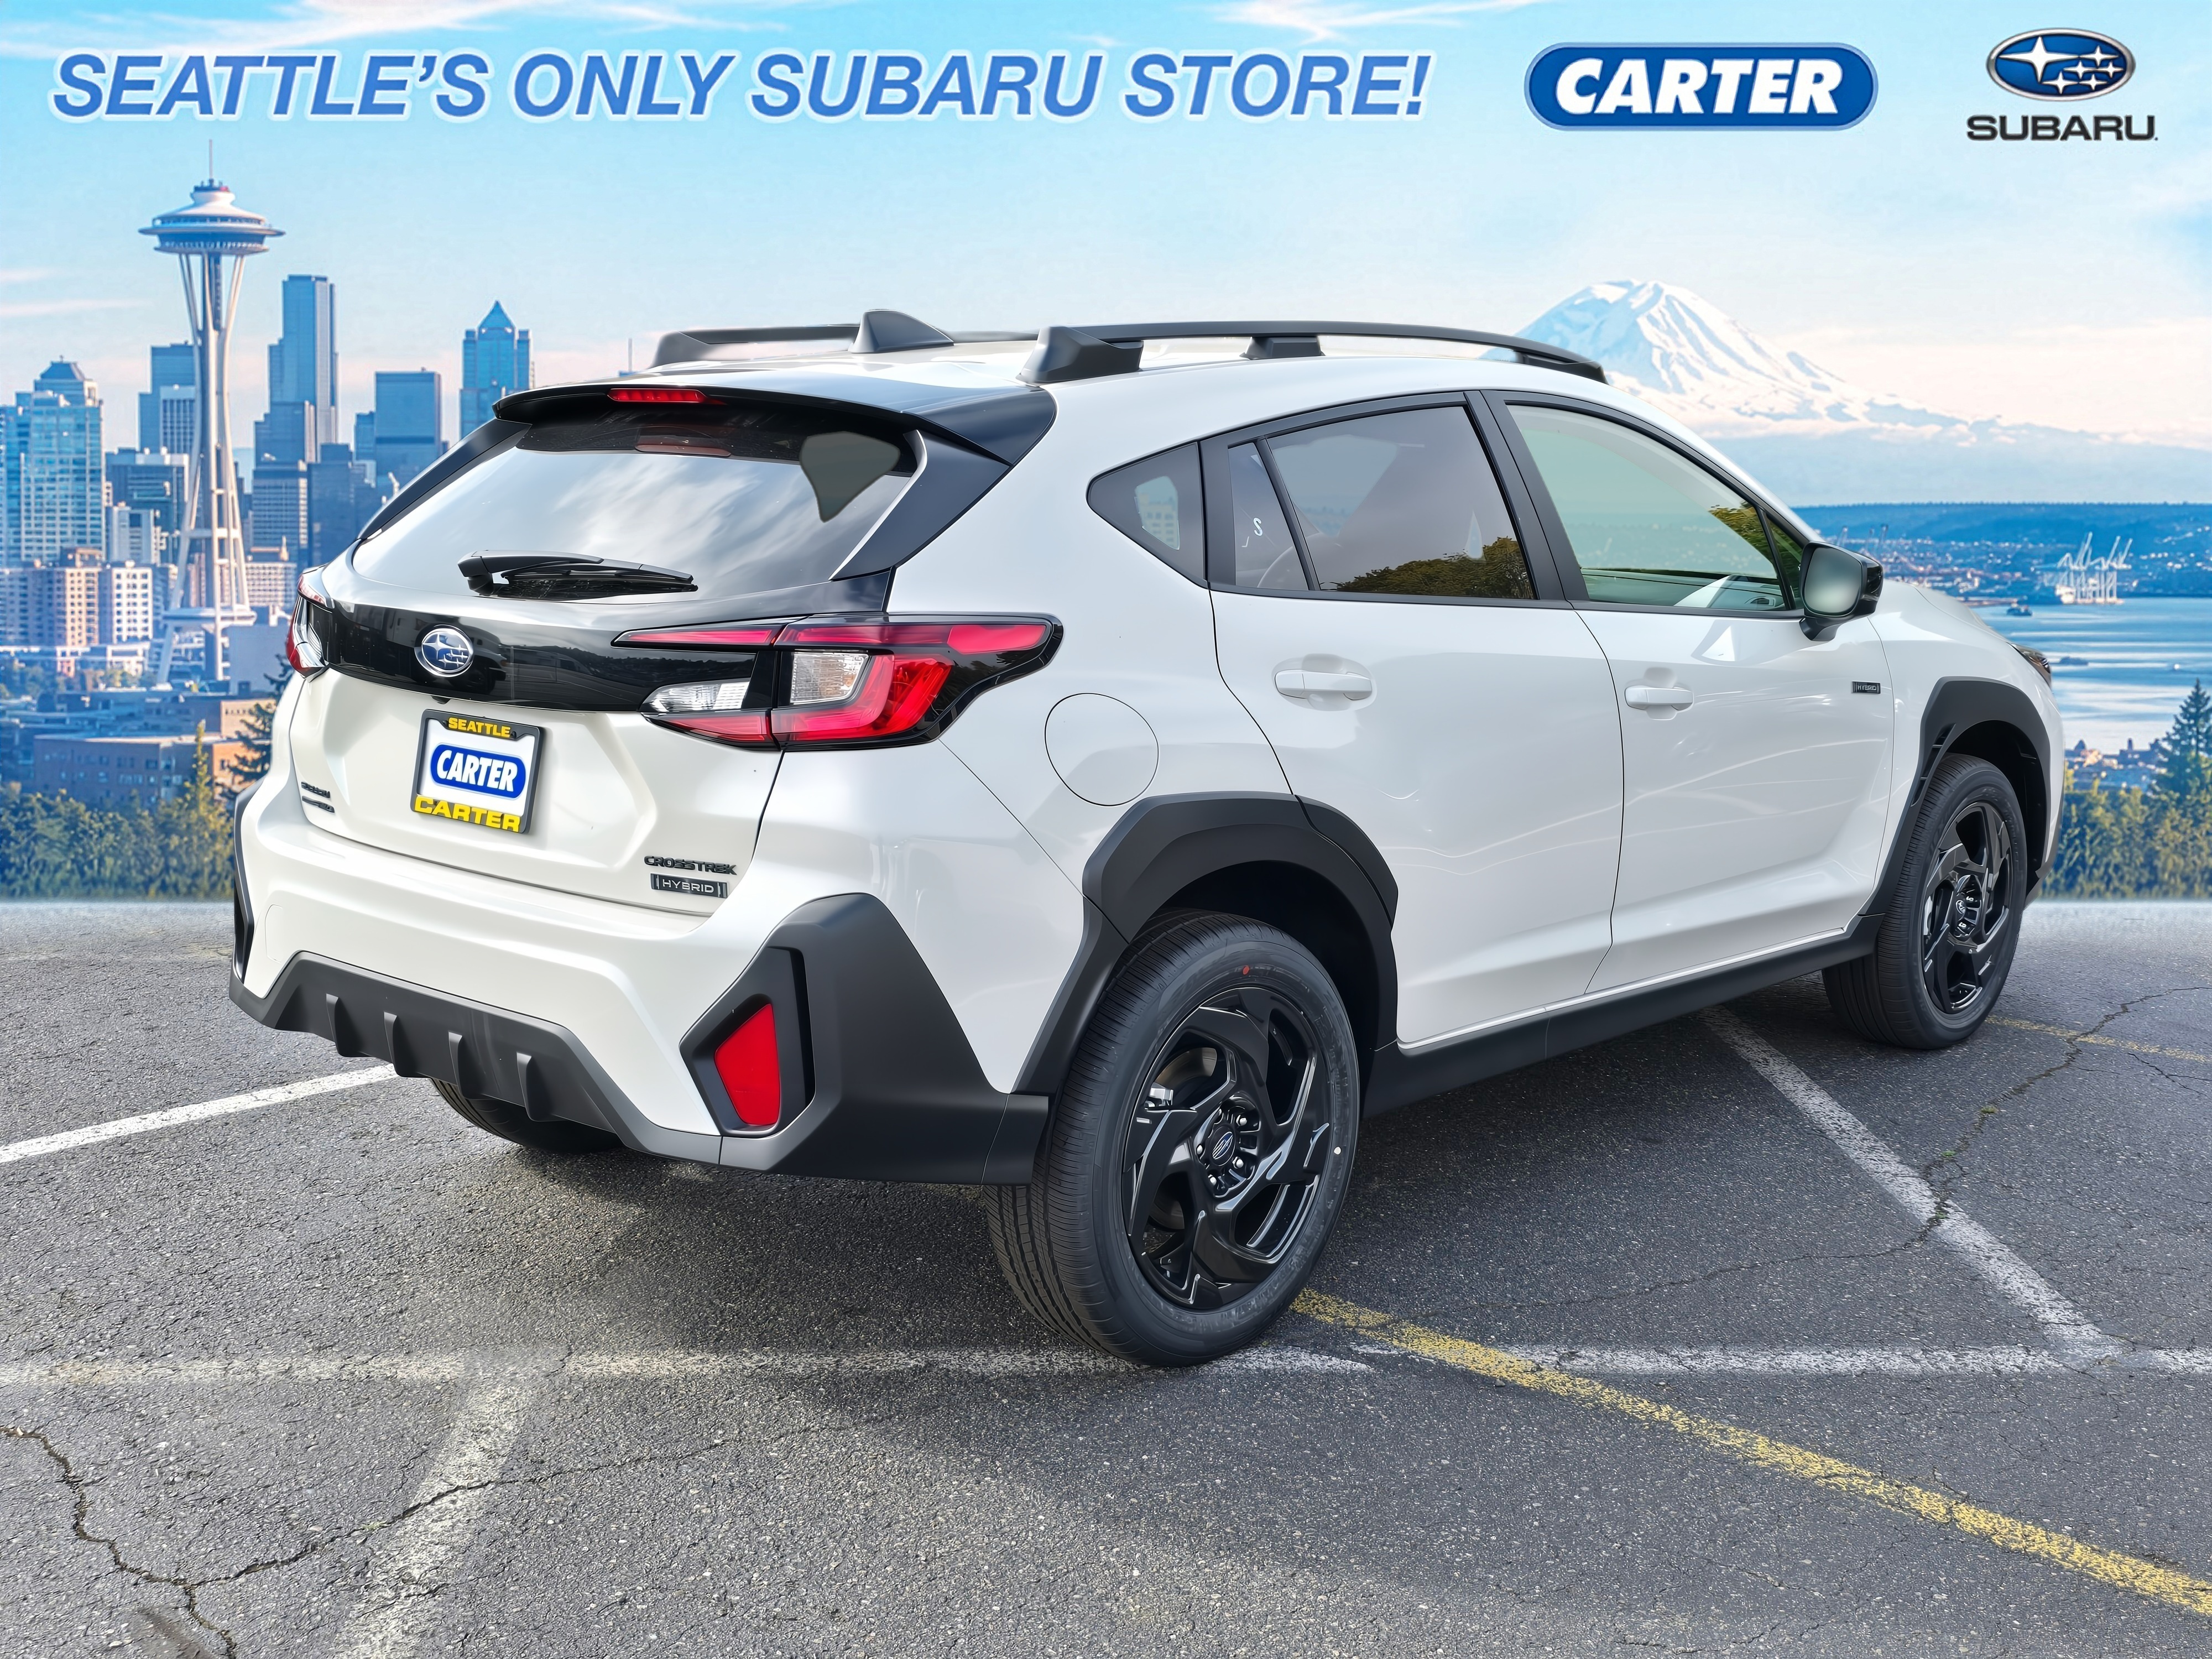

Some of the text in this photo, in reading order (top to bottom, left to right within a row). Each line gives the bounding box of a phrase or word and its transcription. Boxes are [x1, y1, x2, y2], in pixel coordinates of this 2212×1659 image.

[448, 717, 511, 738] SEATTLE
[436, 749, 518, 792] CARTER
[415, 795, 521, 832] CARTER
[644, 855, 738, 875] CROSSTREK
[662, 879, 714, 894] HYBRID
